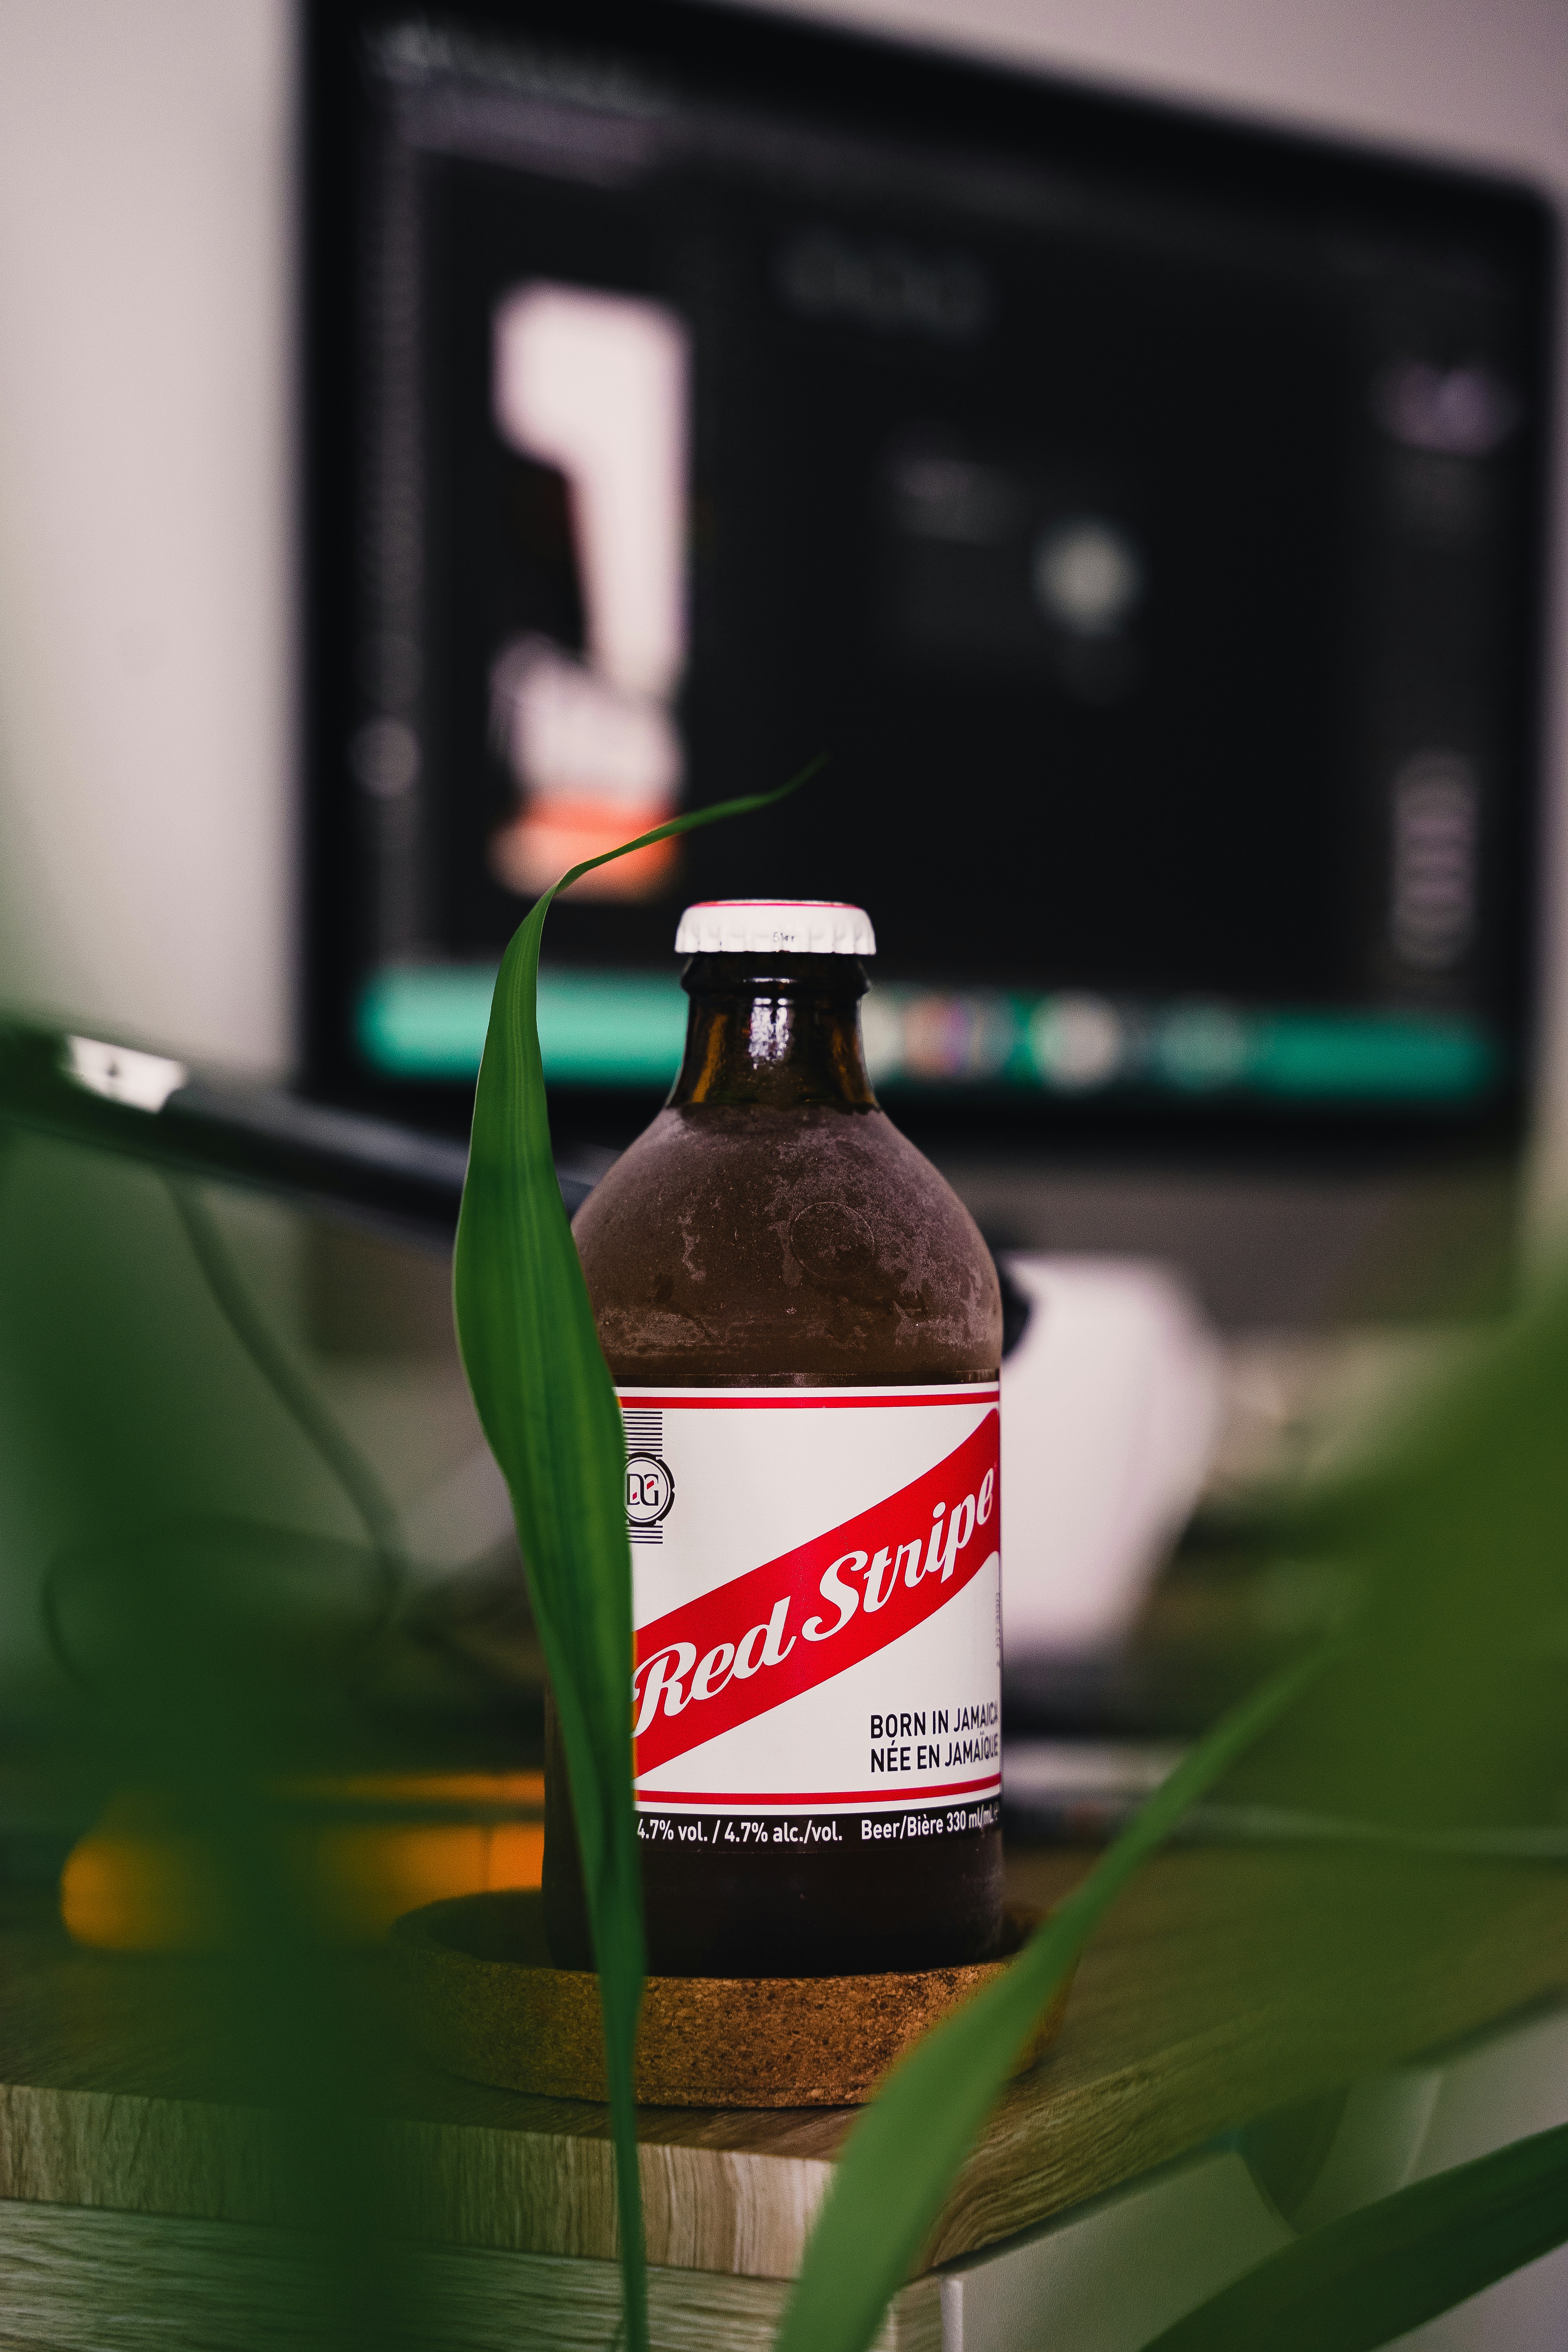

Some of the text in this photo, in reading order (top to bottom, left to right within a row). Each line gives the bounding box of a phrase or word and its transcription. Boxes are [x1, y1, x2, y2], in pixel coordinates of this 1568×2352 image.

[630, 1596, 796, 1738] Red
[802, 1467, 994, 1641] Stripe
[871, 1711, 926, 1739] BORN
[933, 1709, 948, 1735] IN
[871, 1730, 998, 1773] NÉE EN JAMAÏQUE
[637, 1819, 842, 1844] 4.7% vol. / 4.7% alc./vol.
[862, 1814, 943, 1839] Beer/Bière
[947, 1810, 966, 1832] 330
